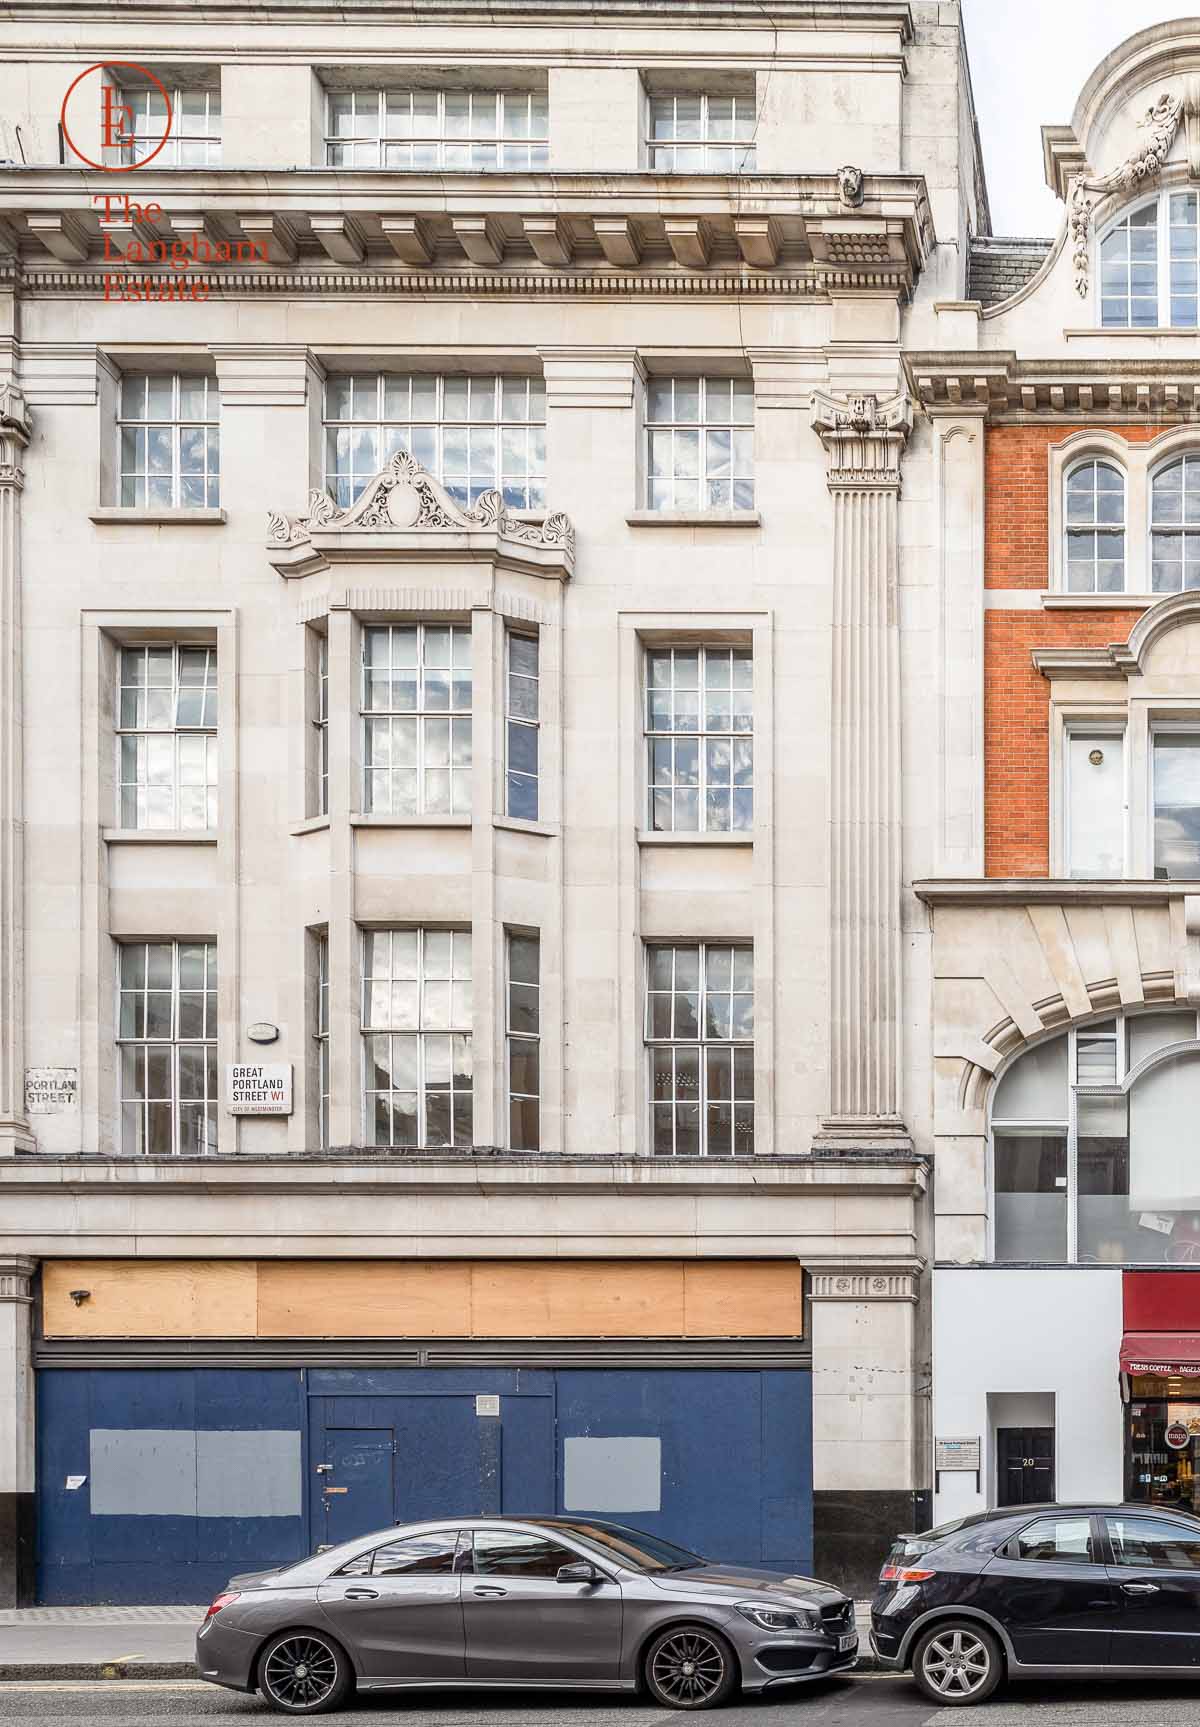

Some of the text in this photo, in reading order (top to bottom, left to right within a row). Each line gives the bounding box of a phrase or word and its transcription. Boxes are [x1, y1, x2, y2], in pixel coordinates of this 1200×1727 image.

[232, 1067, 264, 1078] GREAT
[232, 1079, 283, 1090] PORTLAND
[232, 1090, 284, 1102] STREET W1
[1149, 1364, 1172, 1372] COFFEE
[1168, 1432, 1187, 1440] mapa
[1023, 1458, 1034, 1467] 20
